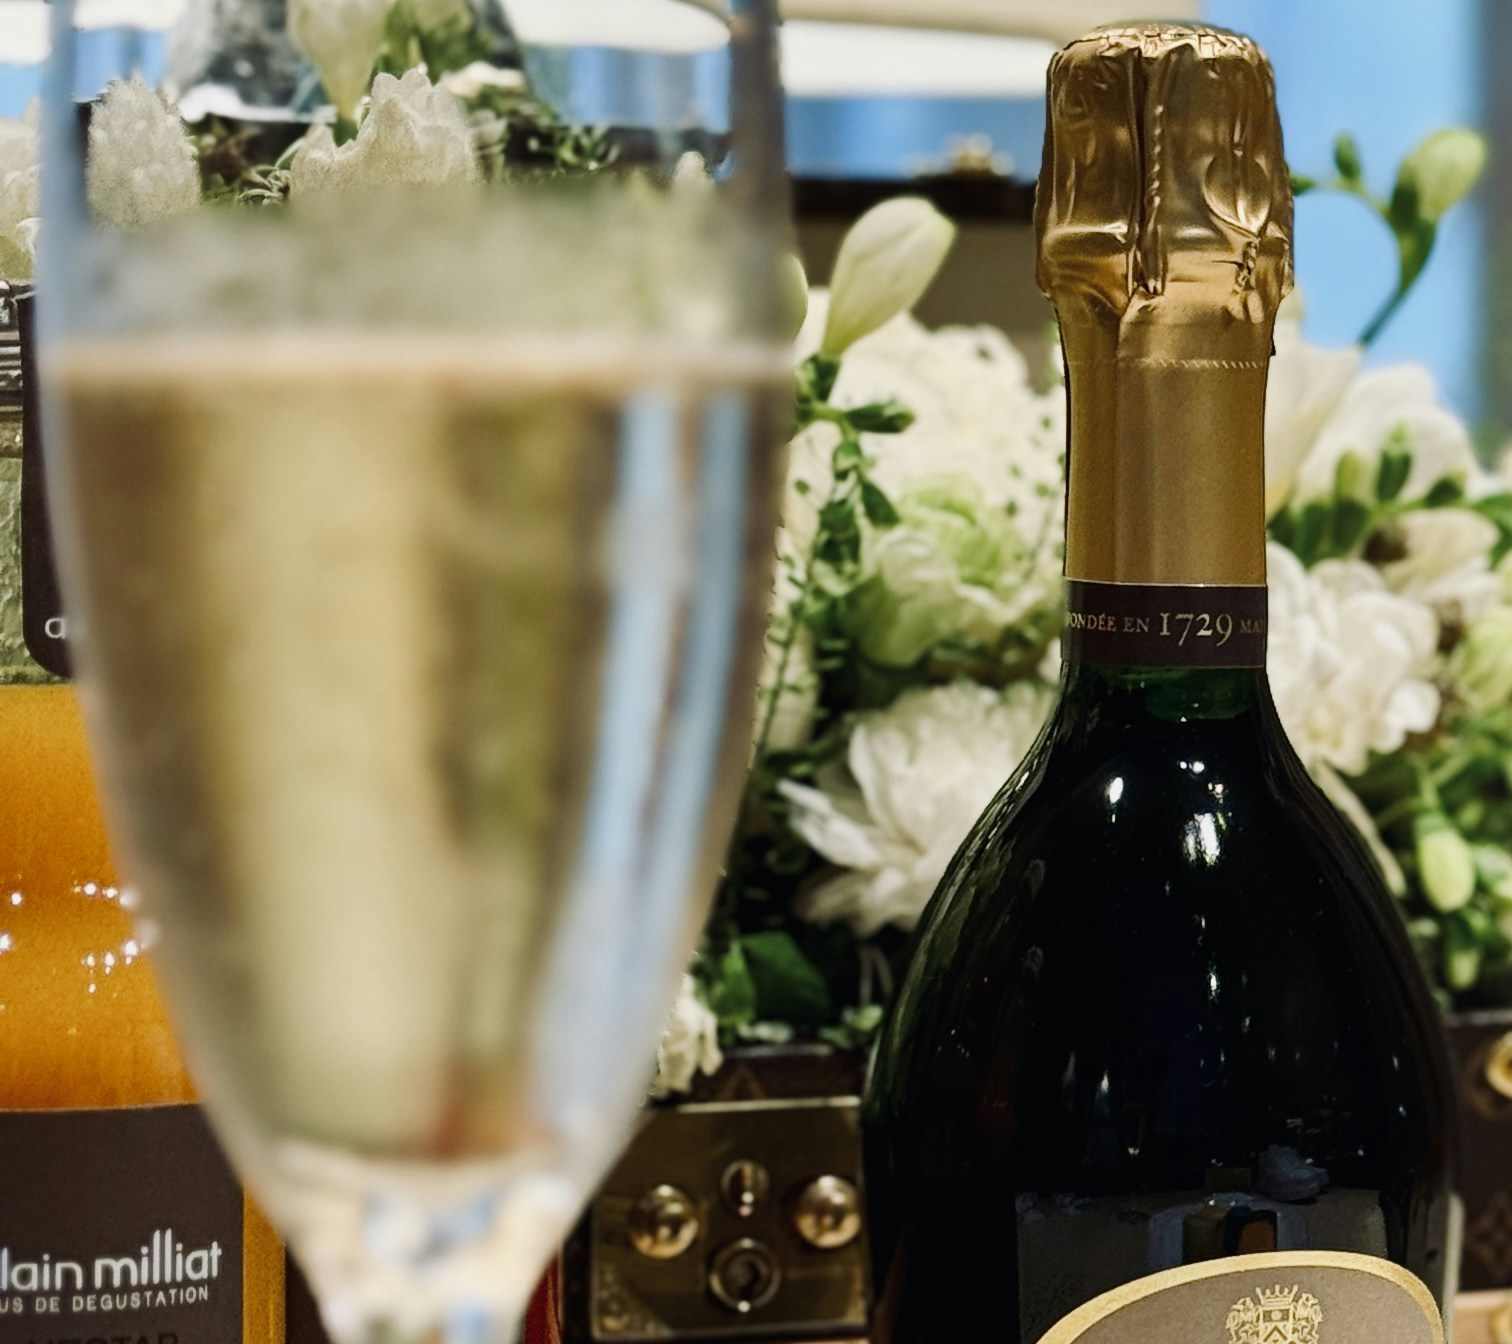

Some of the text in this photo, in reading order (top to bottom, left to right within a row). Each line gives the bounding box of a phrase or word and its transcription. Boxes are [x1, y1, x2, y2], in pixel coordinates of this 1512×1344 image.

[1122, 616, 1150, 633] EN
[1159, 612, 1233, 646] 1729
[0, 1228, 222, 1292] lain milliat
[35, 1296, 60, 1313] DE
